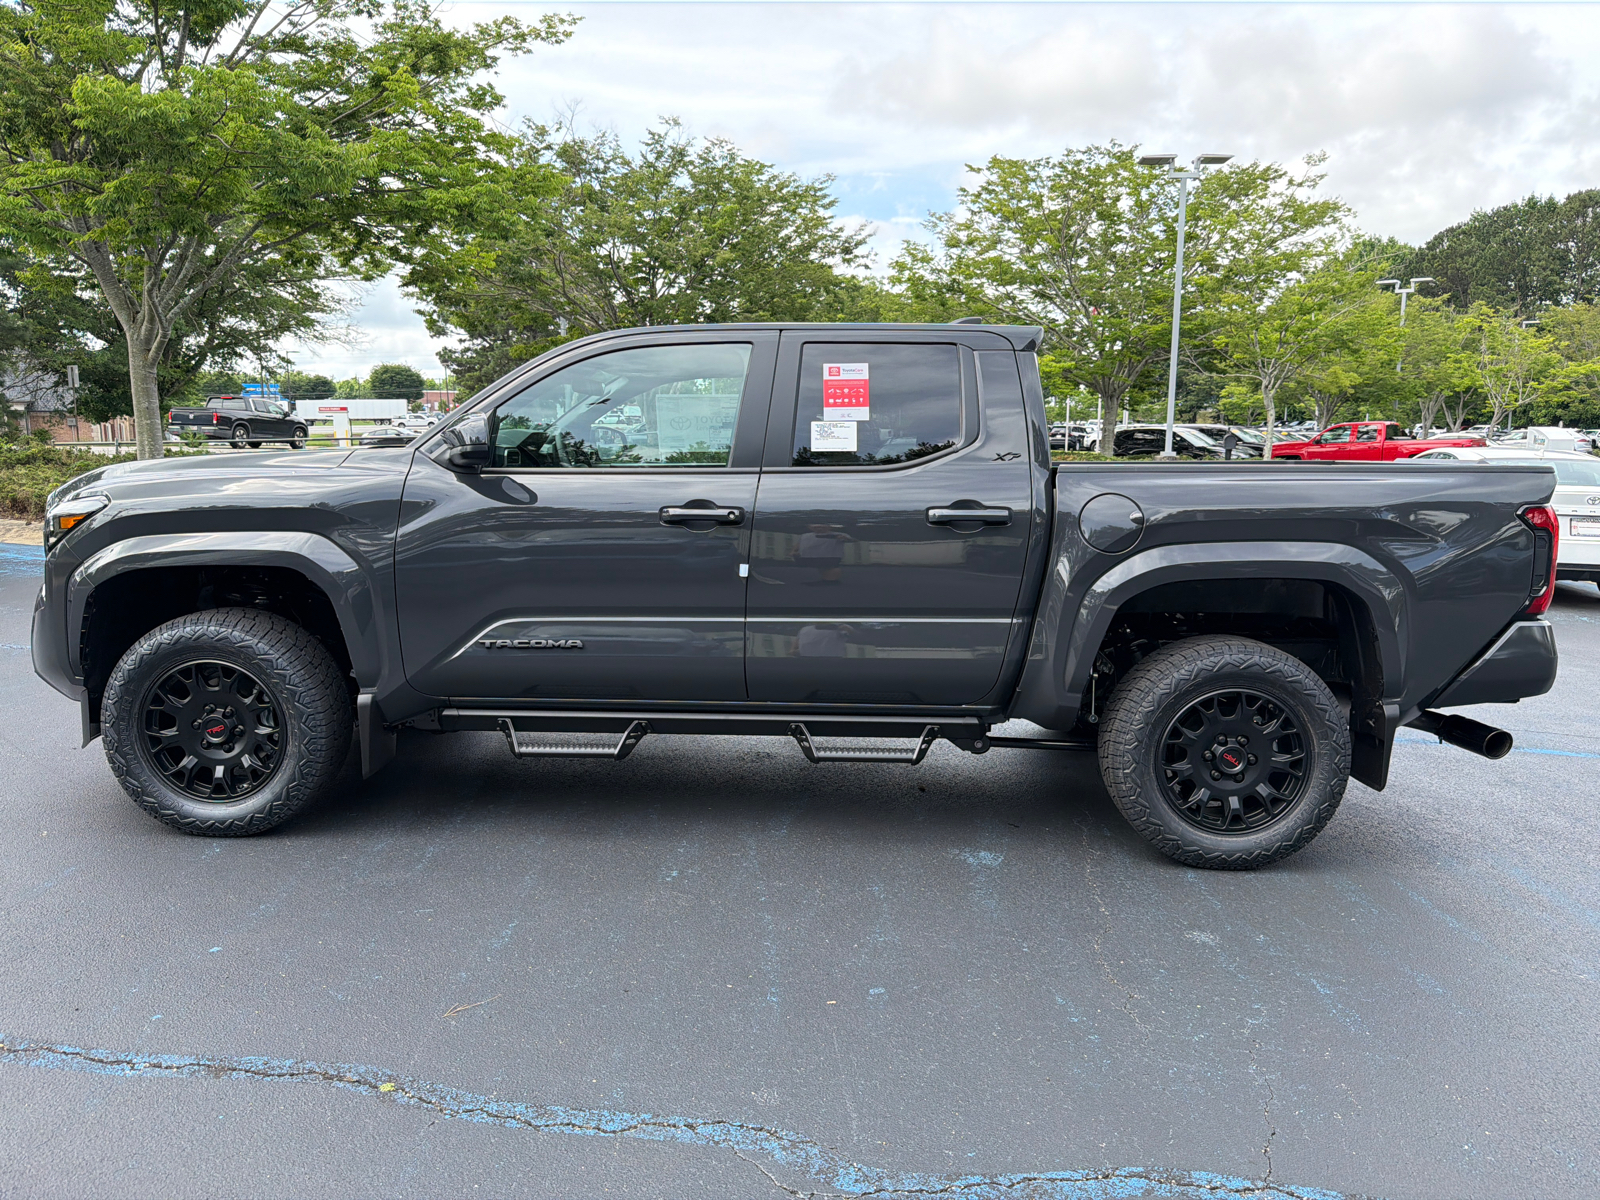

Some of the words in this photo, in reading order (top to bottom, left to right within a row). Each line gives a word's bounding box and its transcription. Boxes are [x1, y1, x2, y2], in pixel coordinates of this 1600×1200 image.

[479, 640, 583, 649] TACOMA
[206, 724, 225, 734] TRD
[1222, 752, 1239, 767] TRD
